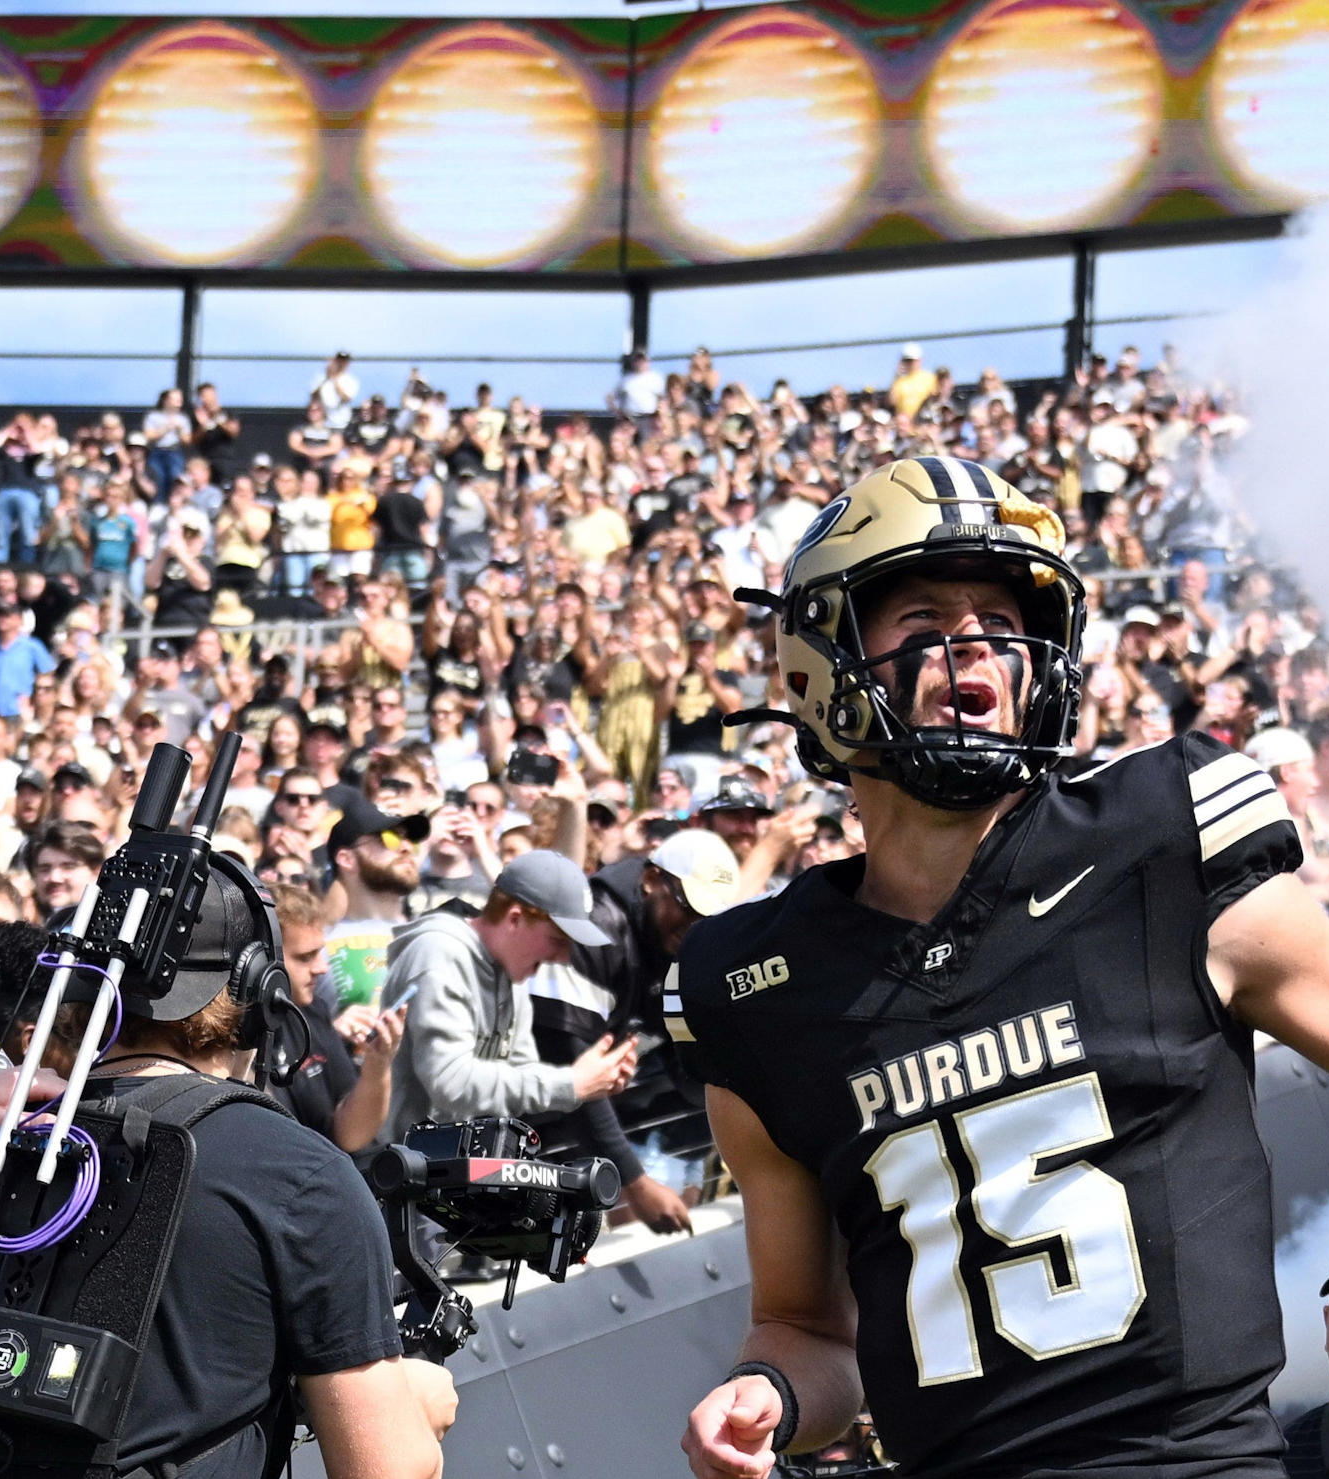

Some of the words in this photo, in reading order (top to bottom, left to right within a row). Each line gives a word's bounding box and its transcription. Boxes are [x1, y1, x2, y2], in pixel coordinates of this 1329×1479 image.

[924, 942, 958, 971] P
[846, 1001, 1087, 1133] PURDUE
[501, 1162, 558, 1188] RONIN
[862, 1071, 1148, 1388] 15
